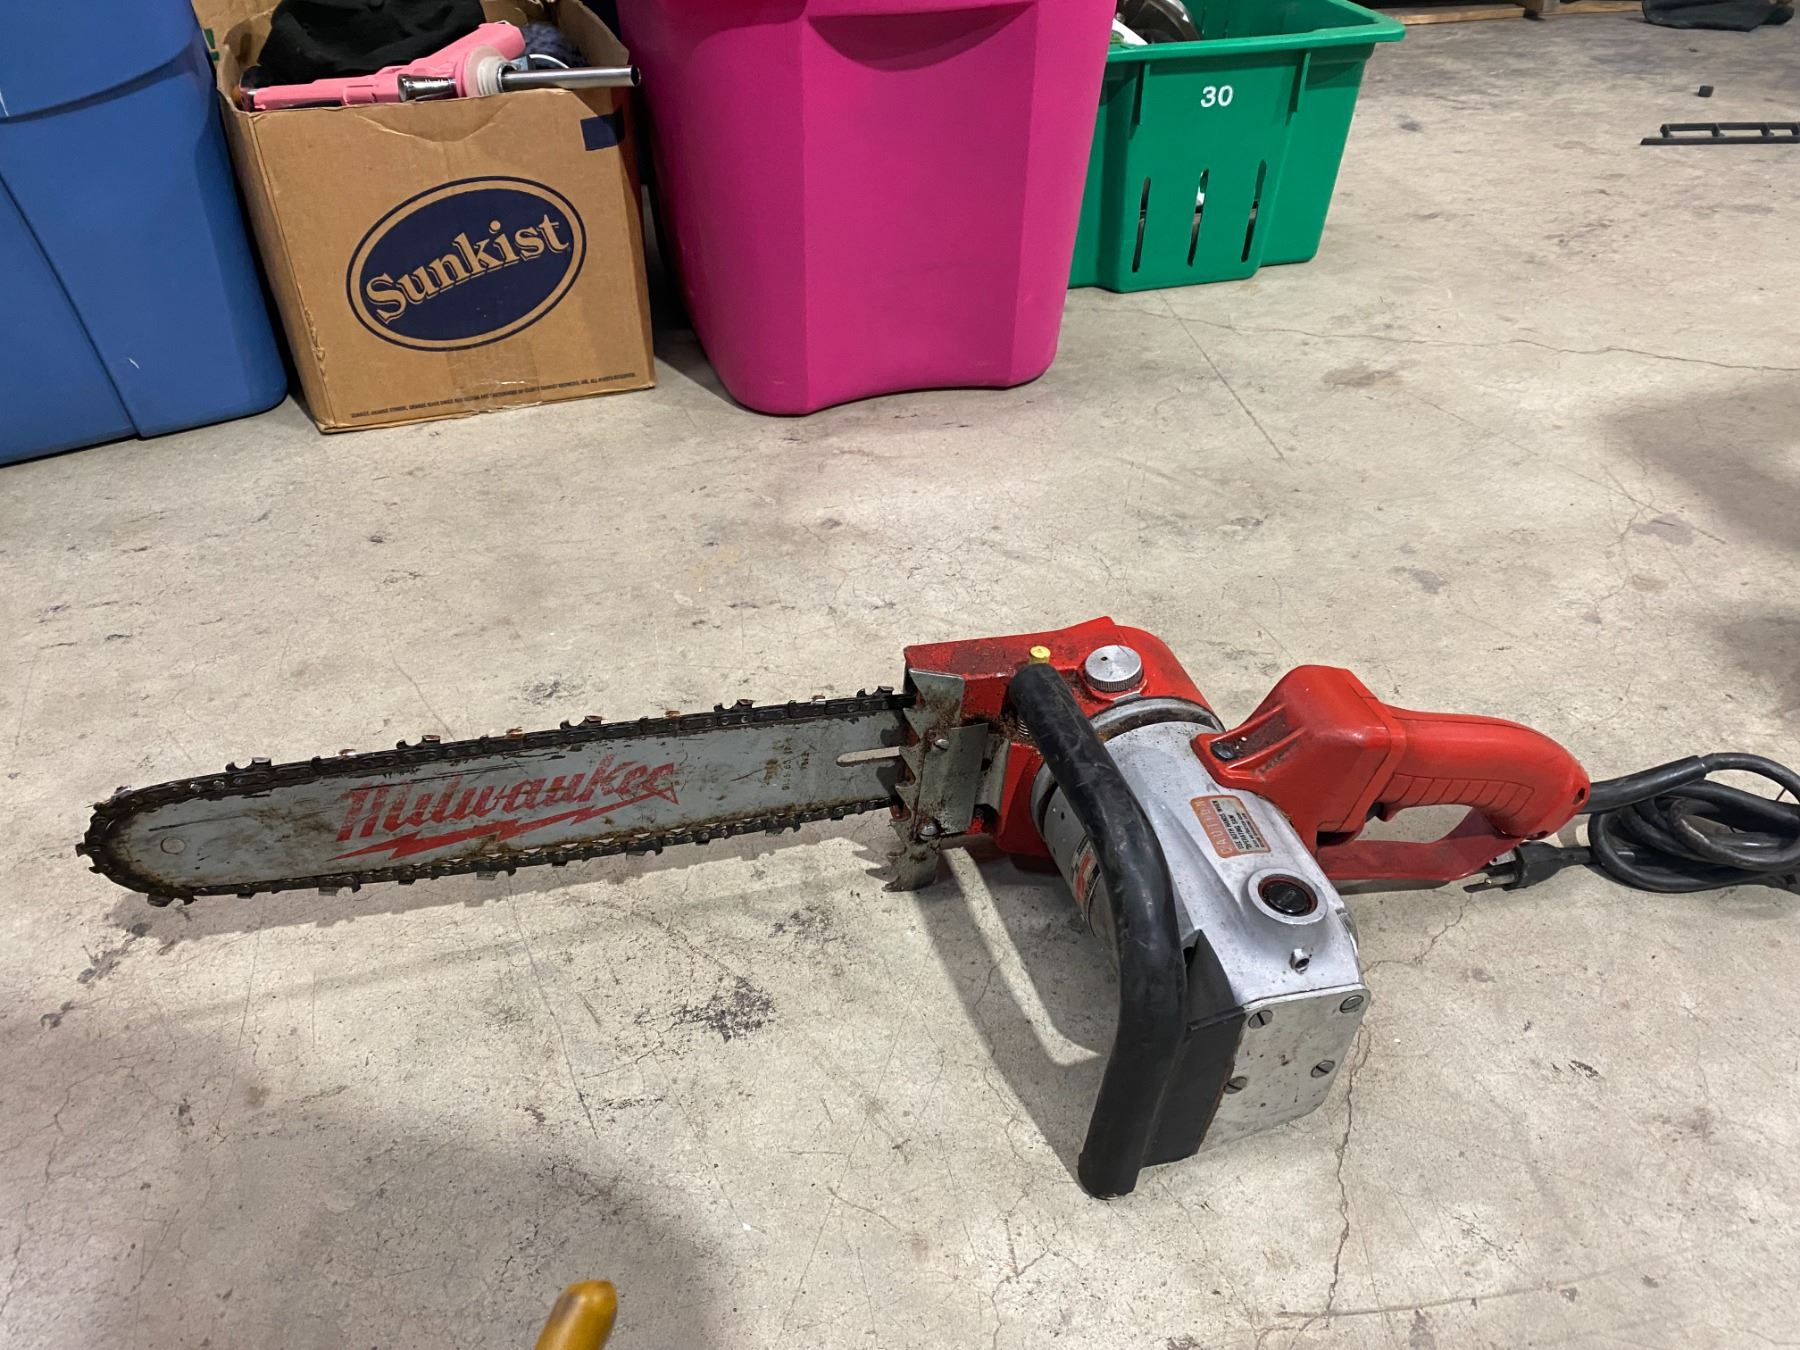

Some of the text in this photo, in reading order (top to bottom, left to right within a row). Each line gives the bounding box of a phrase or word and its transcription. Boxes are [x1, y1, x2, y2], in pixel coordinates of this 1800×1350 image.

[1200, 84, 1233, 107] 30
[366, 214, 570, 324] Sunkist
[335, 754, 679, 843] Milwaukee
[1194, 800, 1232, 853] CAUTION
